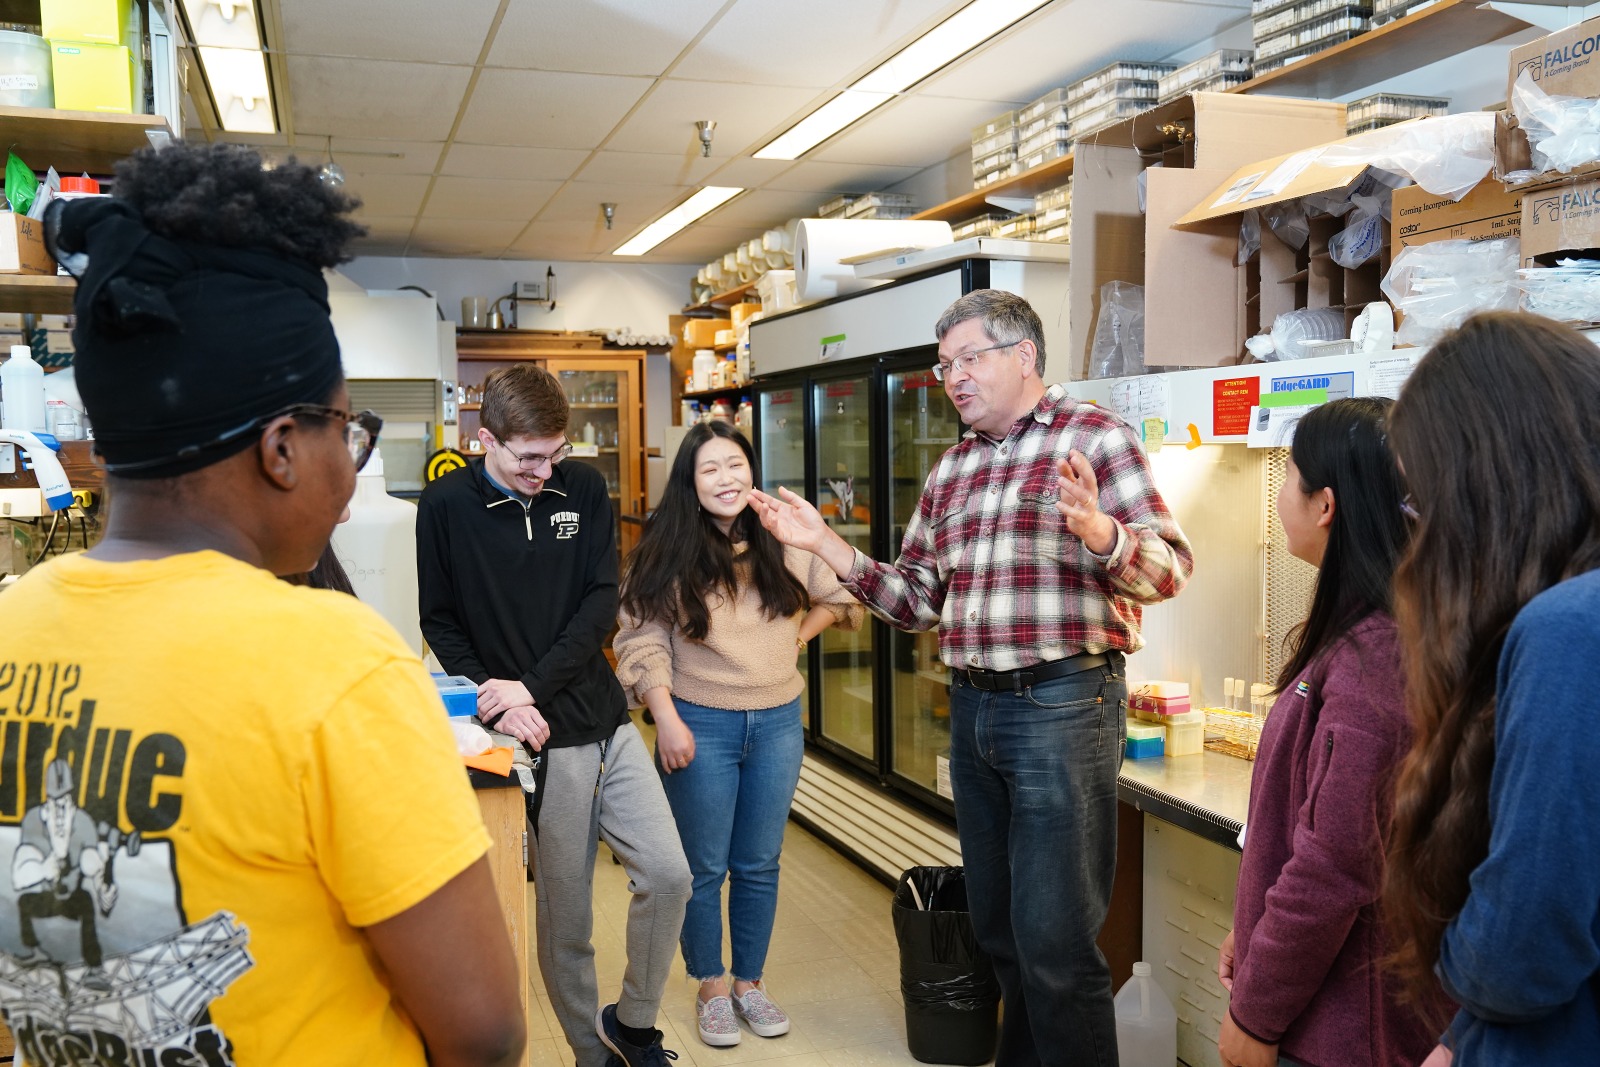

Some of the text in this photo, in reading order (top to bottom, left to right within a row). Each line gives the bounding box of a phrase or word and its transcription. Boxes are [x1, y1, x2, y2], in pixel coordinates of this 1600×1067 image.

[1572, 56, 1591, 69] Brand
[1400, 205, 1422, 217] Corning
[1273, 377, 1330, 392] EdgeGARD
[550, 511, 580, 526] PURDU
[556, 522, 579, 539] P
[0, 662, 81, 719] 2012
